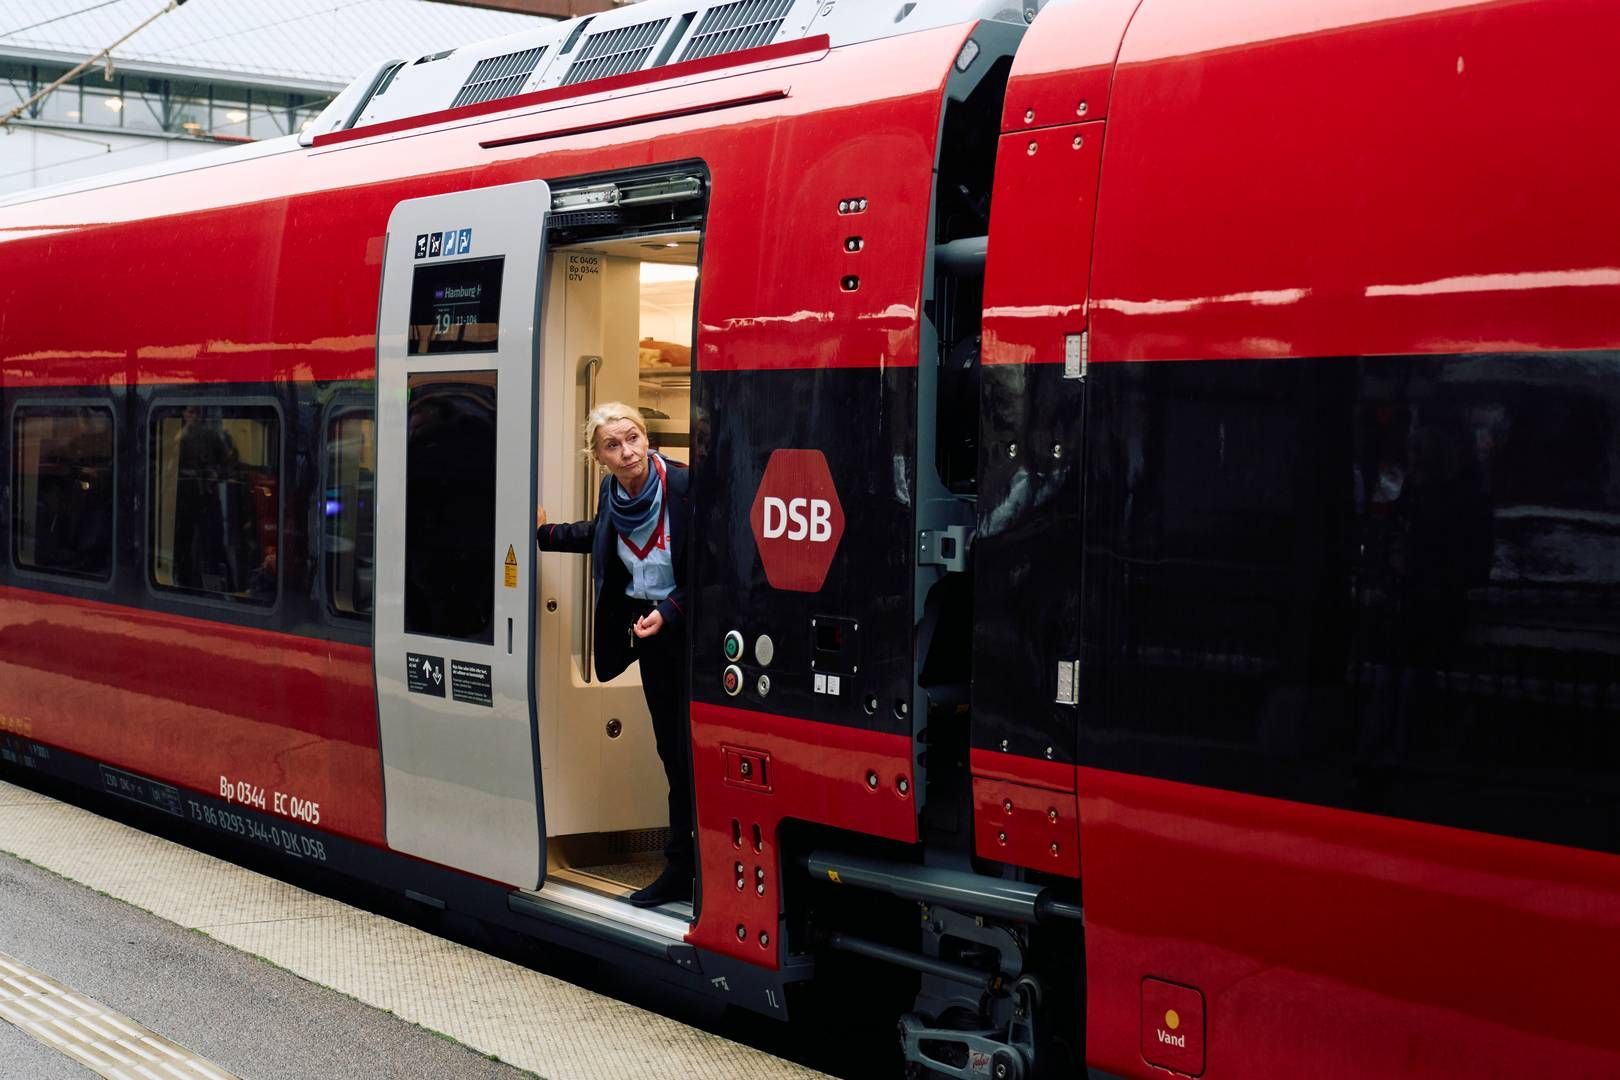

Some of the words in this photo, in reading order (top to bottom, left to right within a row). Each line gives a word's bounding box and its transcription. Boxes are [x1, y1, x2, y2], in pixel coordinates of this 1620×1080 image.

[445, 285, 476, 299] Hamburg
[435, 313, 450, 335] 19
[763, 496, 832, 542] DSB
[220, 776, 235, 804] Bp
[237, 781, 266, 810] 0344
[274, 792, 288, 816] EC
[290, 797, 321, 825] 0405
[188, 800, 202, 821] 73
[203, 805, 218, 826] 86
[219, 809, 245, 835] 8293
[246, 818, 280, 846] 344-0
[281, 830, 301, 853] DK
[301, 836, 328, 861] DSB
[1157, 1028, 1185, 1048] Vand
